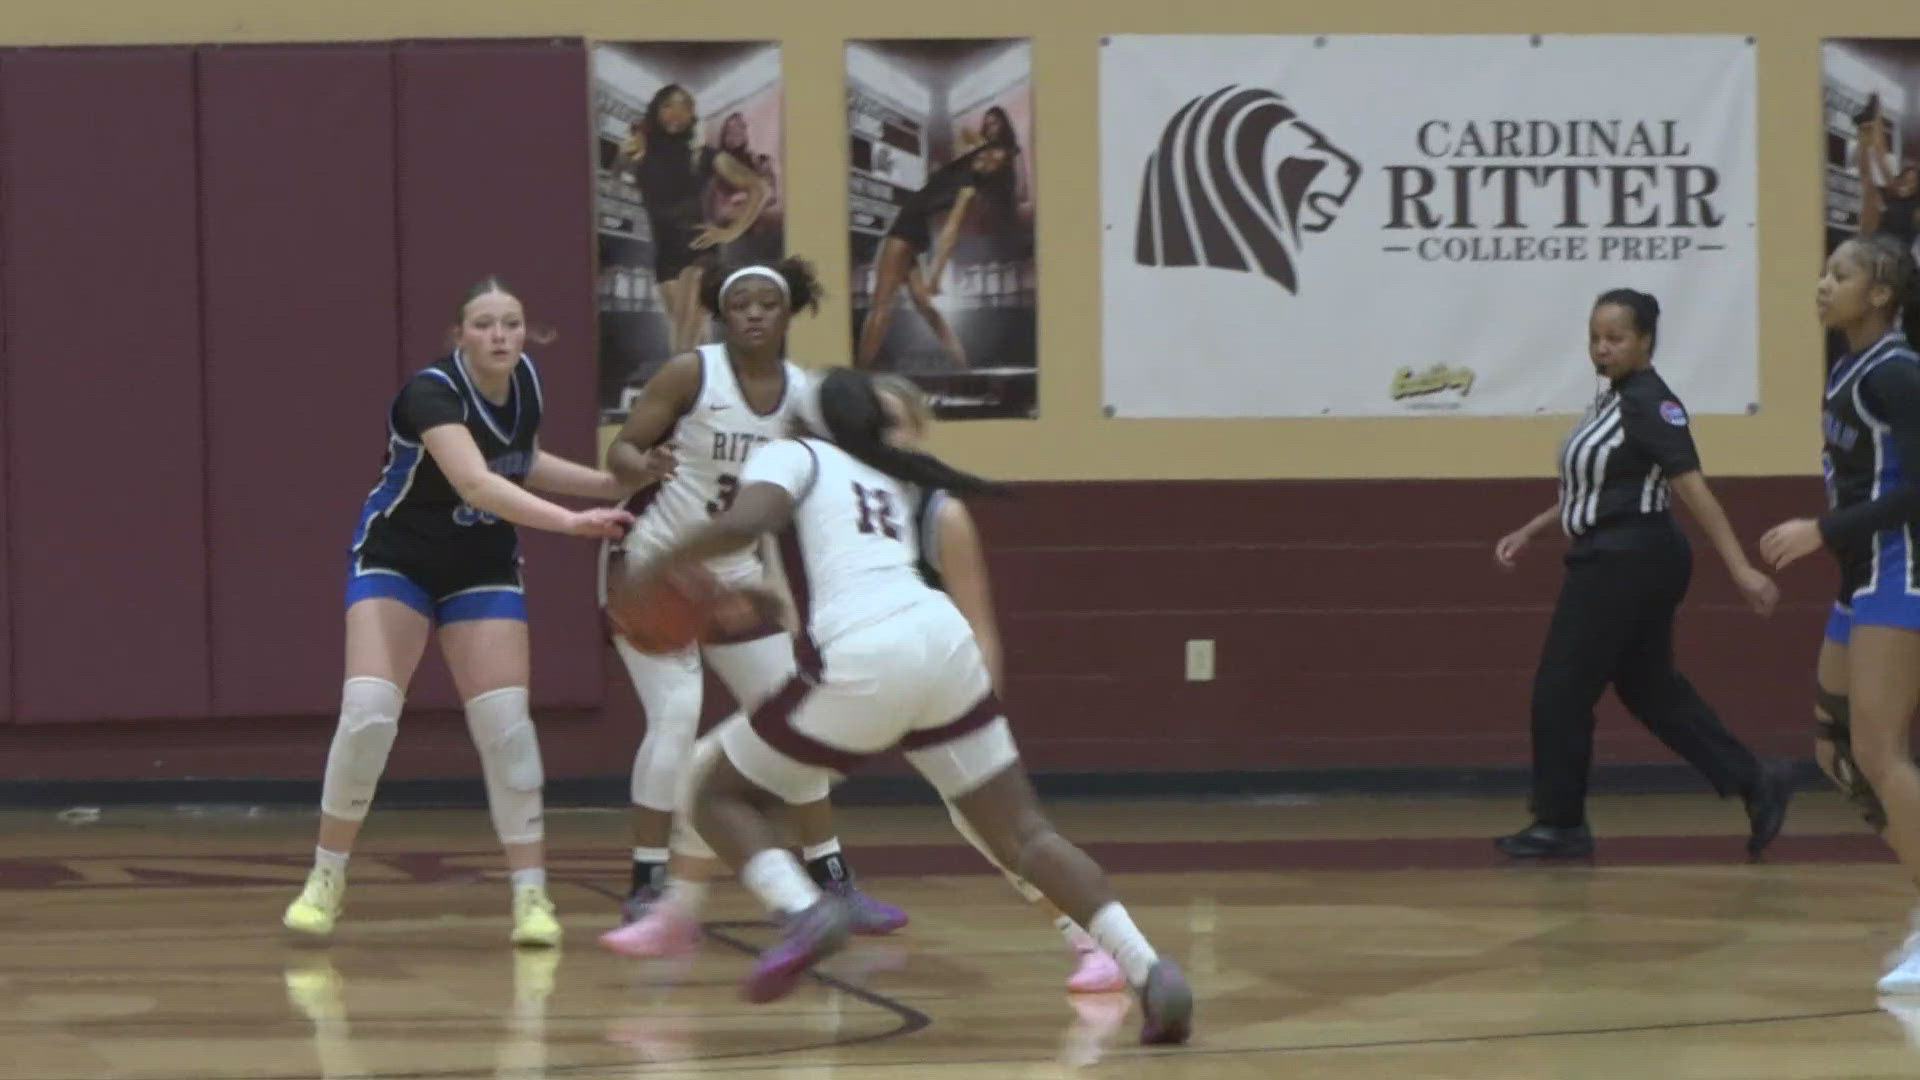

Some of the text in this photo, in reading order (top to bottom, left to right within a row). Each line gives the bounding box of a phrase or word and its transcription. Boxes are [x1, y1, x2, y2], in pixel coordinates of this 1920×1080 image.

[1417, 119, 1690, 158] CARDINAL
[1382, 164, 1725, 229] RITTER
[1418, 235, 1691, 261] COLLEGE PREP
[712, 432, 770, 462] RIT
[852, 480, 902, 540] 12
